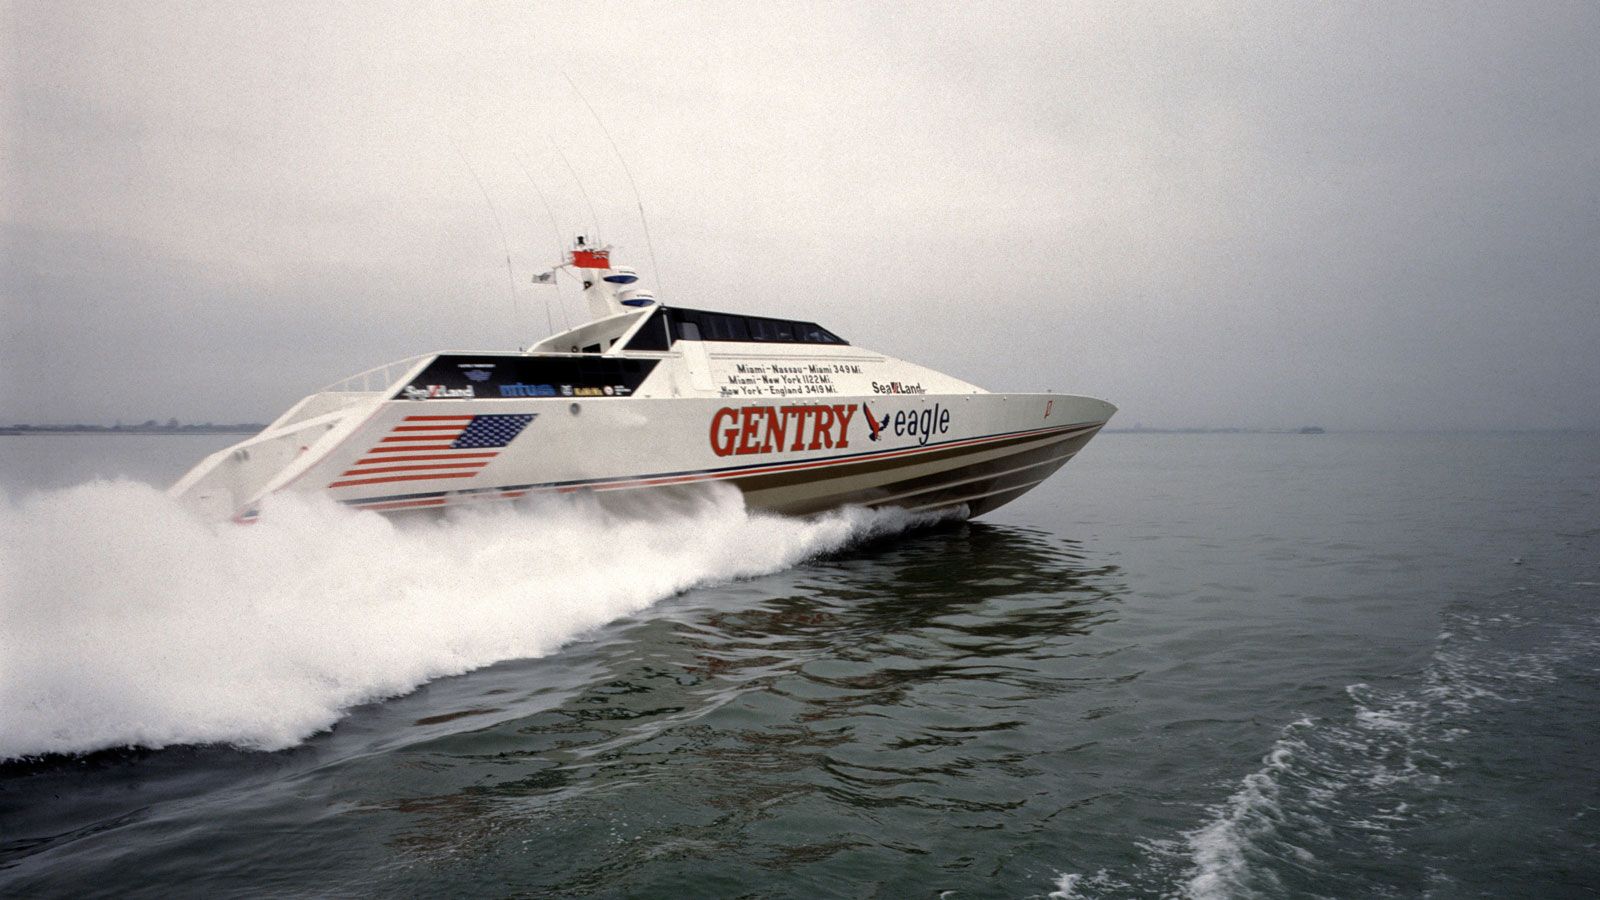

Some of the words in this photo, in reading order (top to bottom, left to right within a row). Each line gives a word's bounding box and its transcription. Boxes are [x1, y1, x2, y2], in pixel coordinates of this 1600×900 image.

[833, 365, 850, 374] 349
[782, 375, 801, 384] York
[805, 385, 824, 395] 3419
[709, 403, 858, 457] GENTRY
[894, 403, 950, 446] eagle
